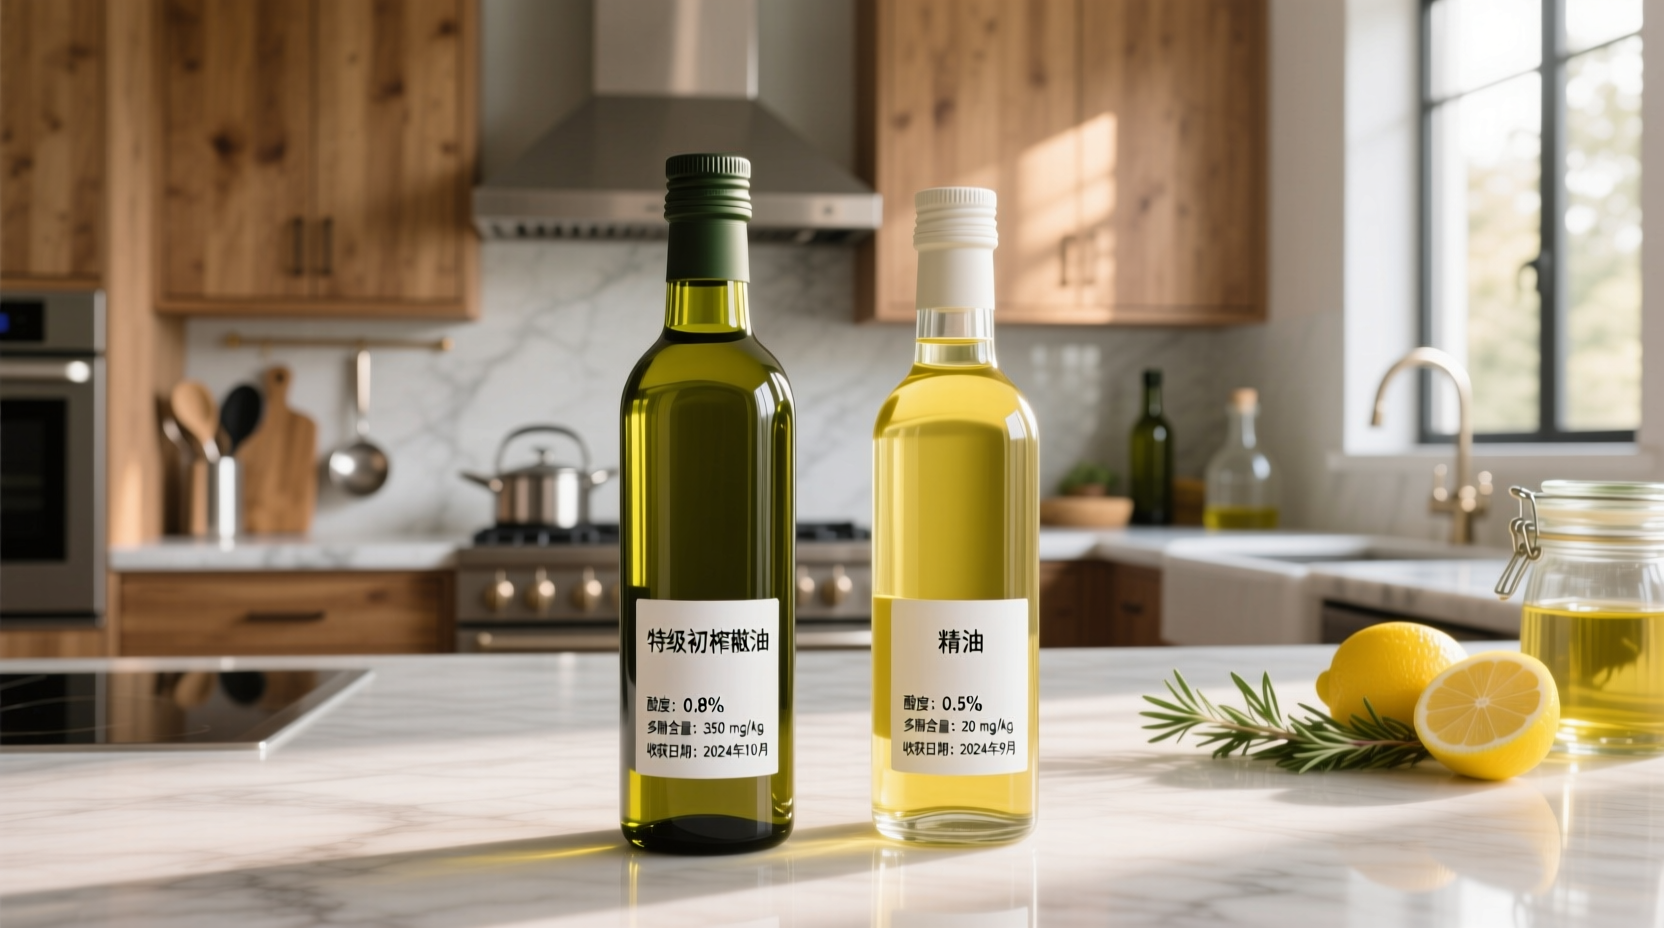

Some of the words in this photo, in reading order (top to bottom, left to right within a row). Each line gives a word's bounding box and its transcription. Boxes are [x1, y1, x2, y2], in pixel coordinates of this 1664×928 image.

[937, 628, 984, 655] 精油
[683, 696, 725, 713] 0.8%
[942, 695, 983, 712] 0.5%
[703, 721, 726, 735] 350
[961, 720, 976, 733] 20
[703, 742, 768, 758] 2024年10月
[959, 740, 1016, 756] 2024年9月
